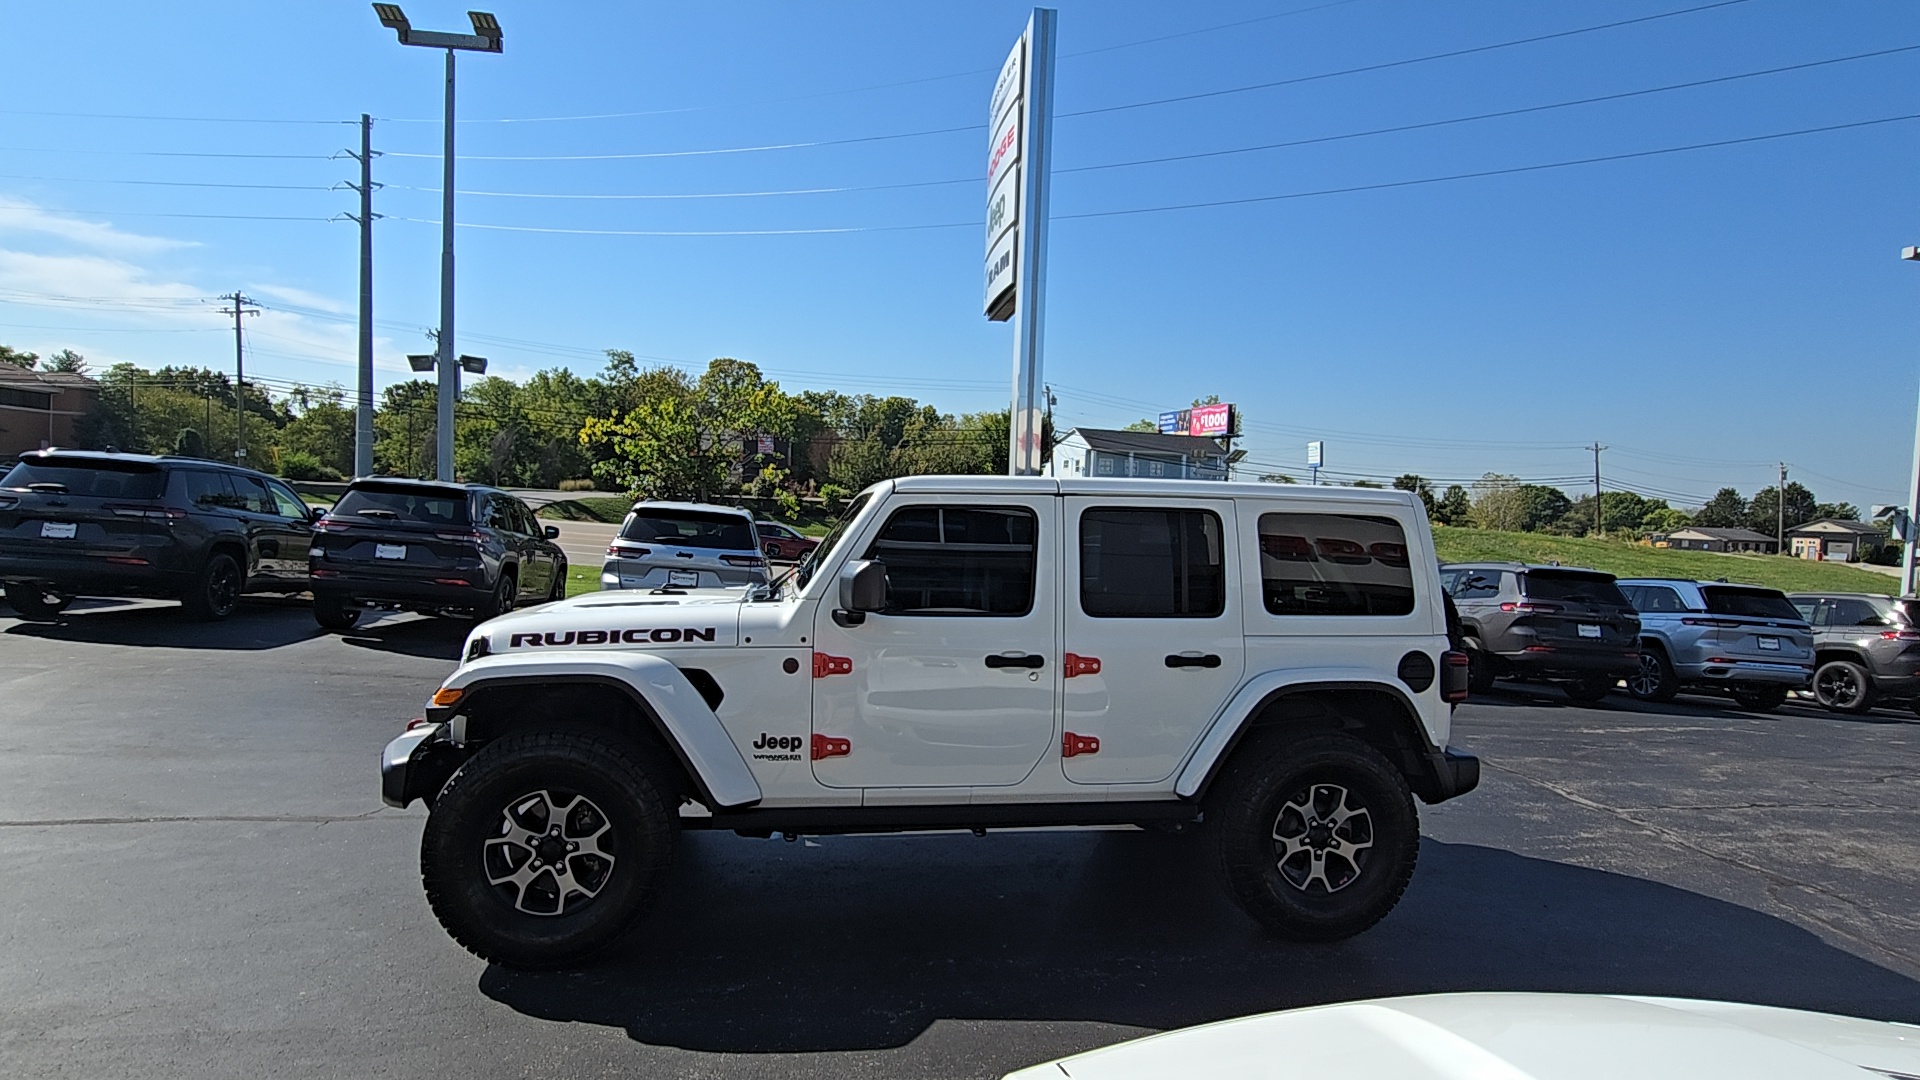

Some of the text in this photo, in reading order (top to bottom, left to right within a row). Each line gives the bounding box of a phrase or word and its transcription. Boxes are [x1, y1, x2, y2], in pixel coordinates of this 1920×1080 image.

[990, 57, 1017, 118] RYSLER
[987, 249, 1011, 287] RAM
[510, 627, 716, 648] RUBICON
[752, 732, 803, 753] Jeep
